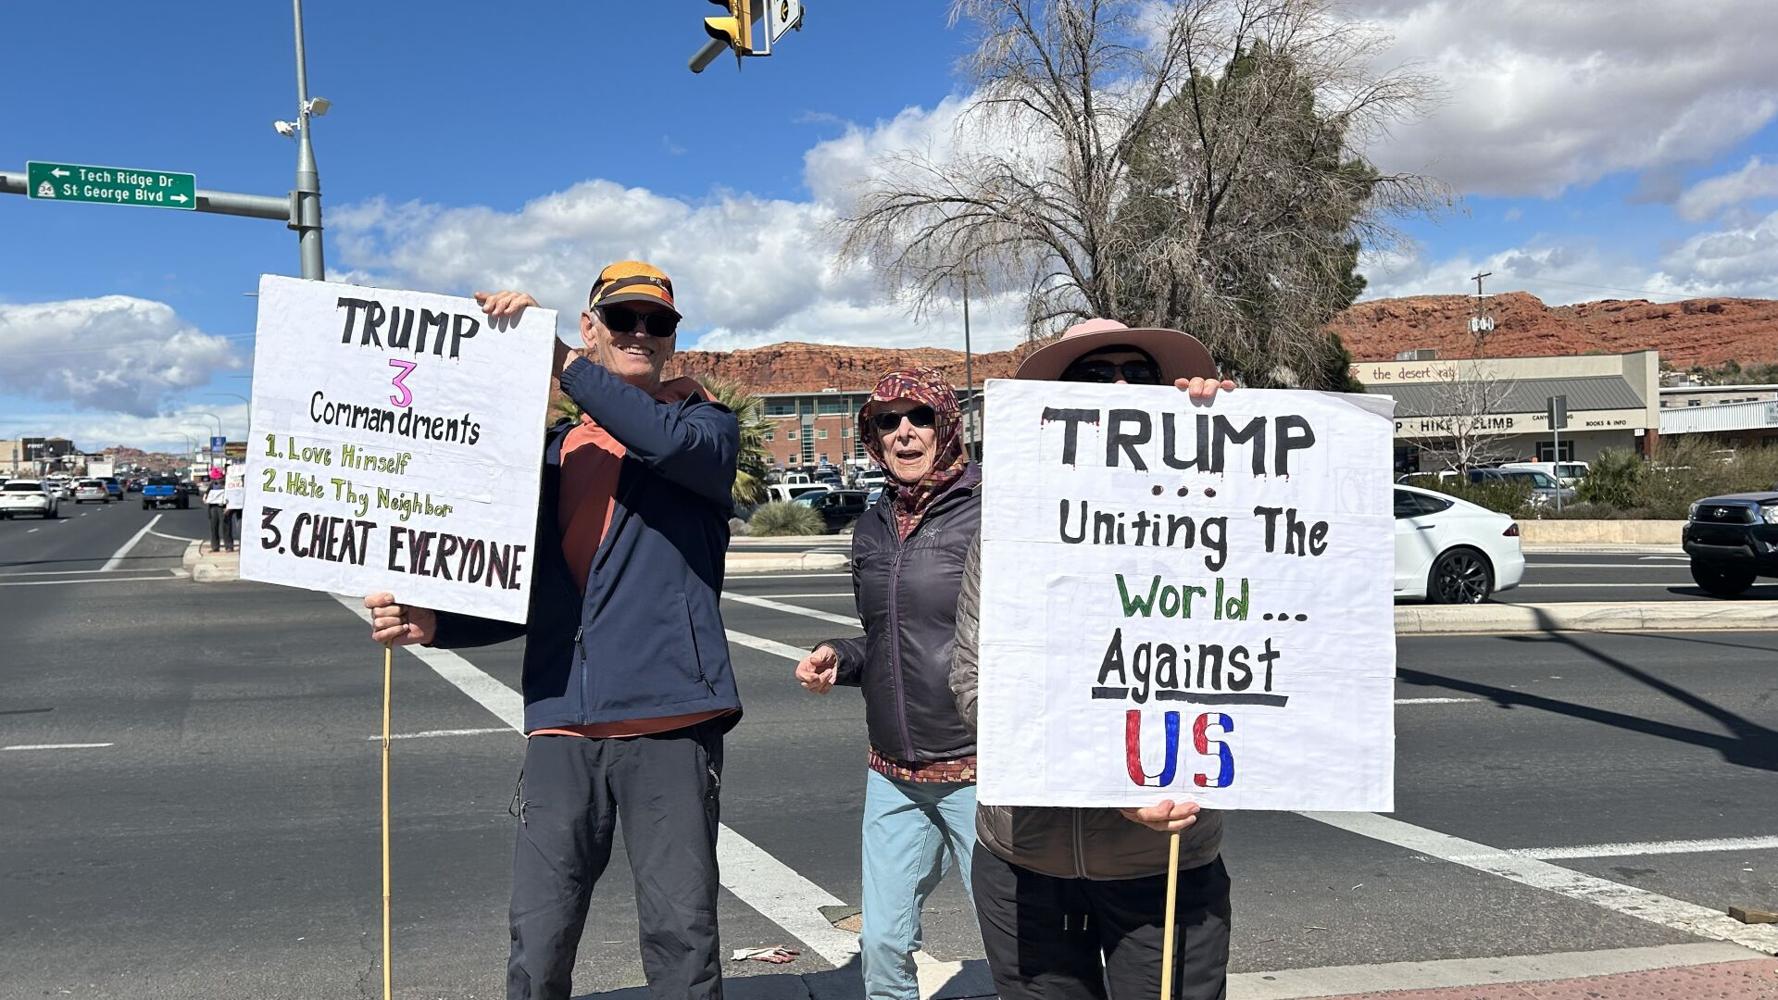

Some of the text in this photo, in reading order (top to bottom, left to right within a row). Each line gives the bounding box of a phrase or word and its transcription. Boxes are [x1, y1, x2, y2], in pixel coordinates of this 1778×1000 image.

[63, 184, 163, 202] St George Blvd
[79, 169, 173, 188] Tech Ridge Dr
[337, 297, 480, 362] TRUMP
[389, 359, 418, 408] 3
[1373, 366, 1391, 380] the
[1398, 367, 1431, 380] desert
[310, 391, 481, 446] Commandments
[1041, 406, 1316, 480] TRUMP
[265, 434, 412, 475] 1. Love Himself
[262, 468, 454, 522] 2. Hate Thy Neighbor
[261, 506, 527, 590] 3. CHEAT EVERYONE
[1060, 498, 1329, 572] Uniting The
[1097, 627, 1281, 704] Against
[1125, 709, 1235, 788] US
